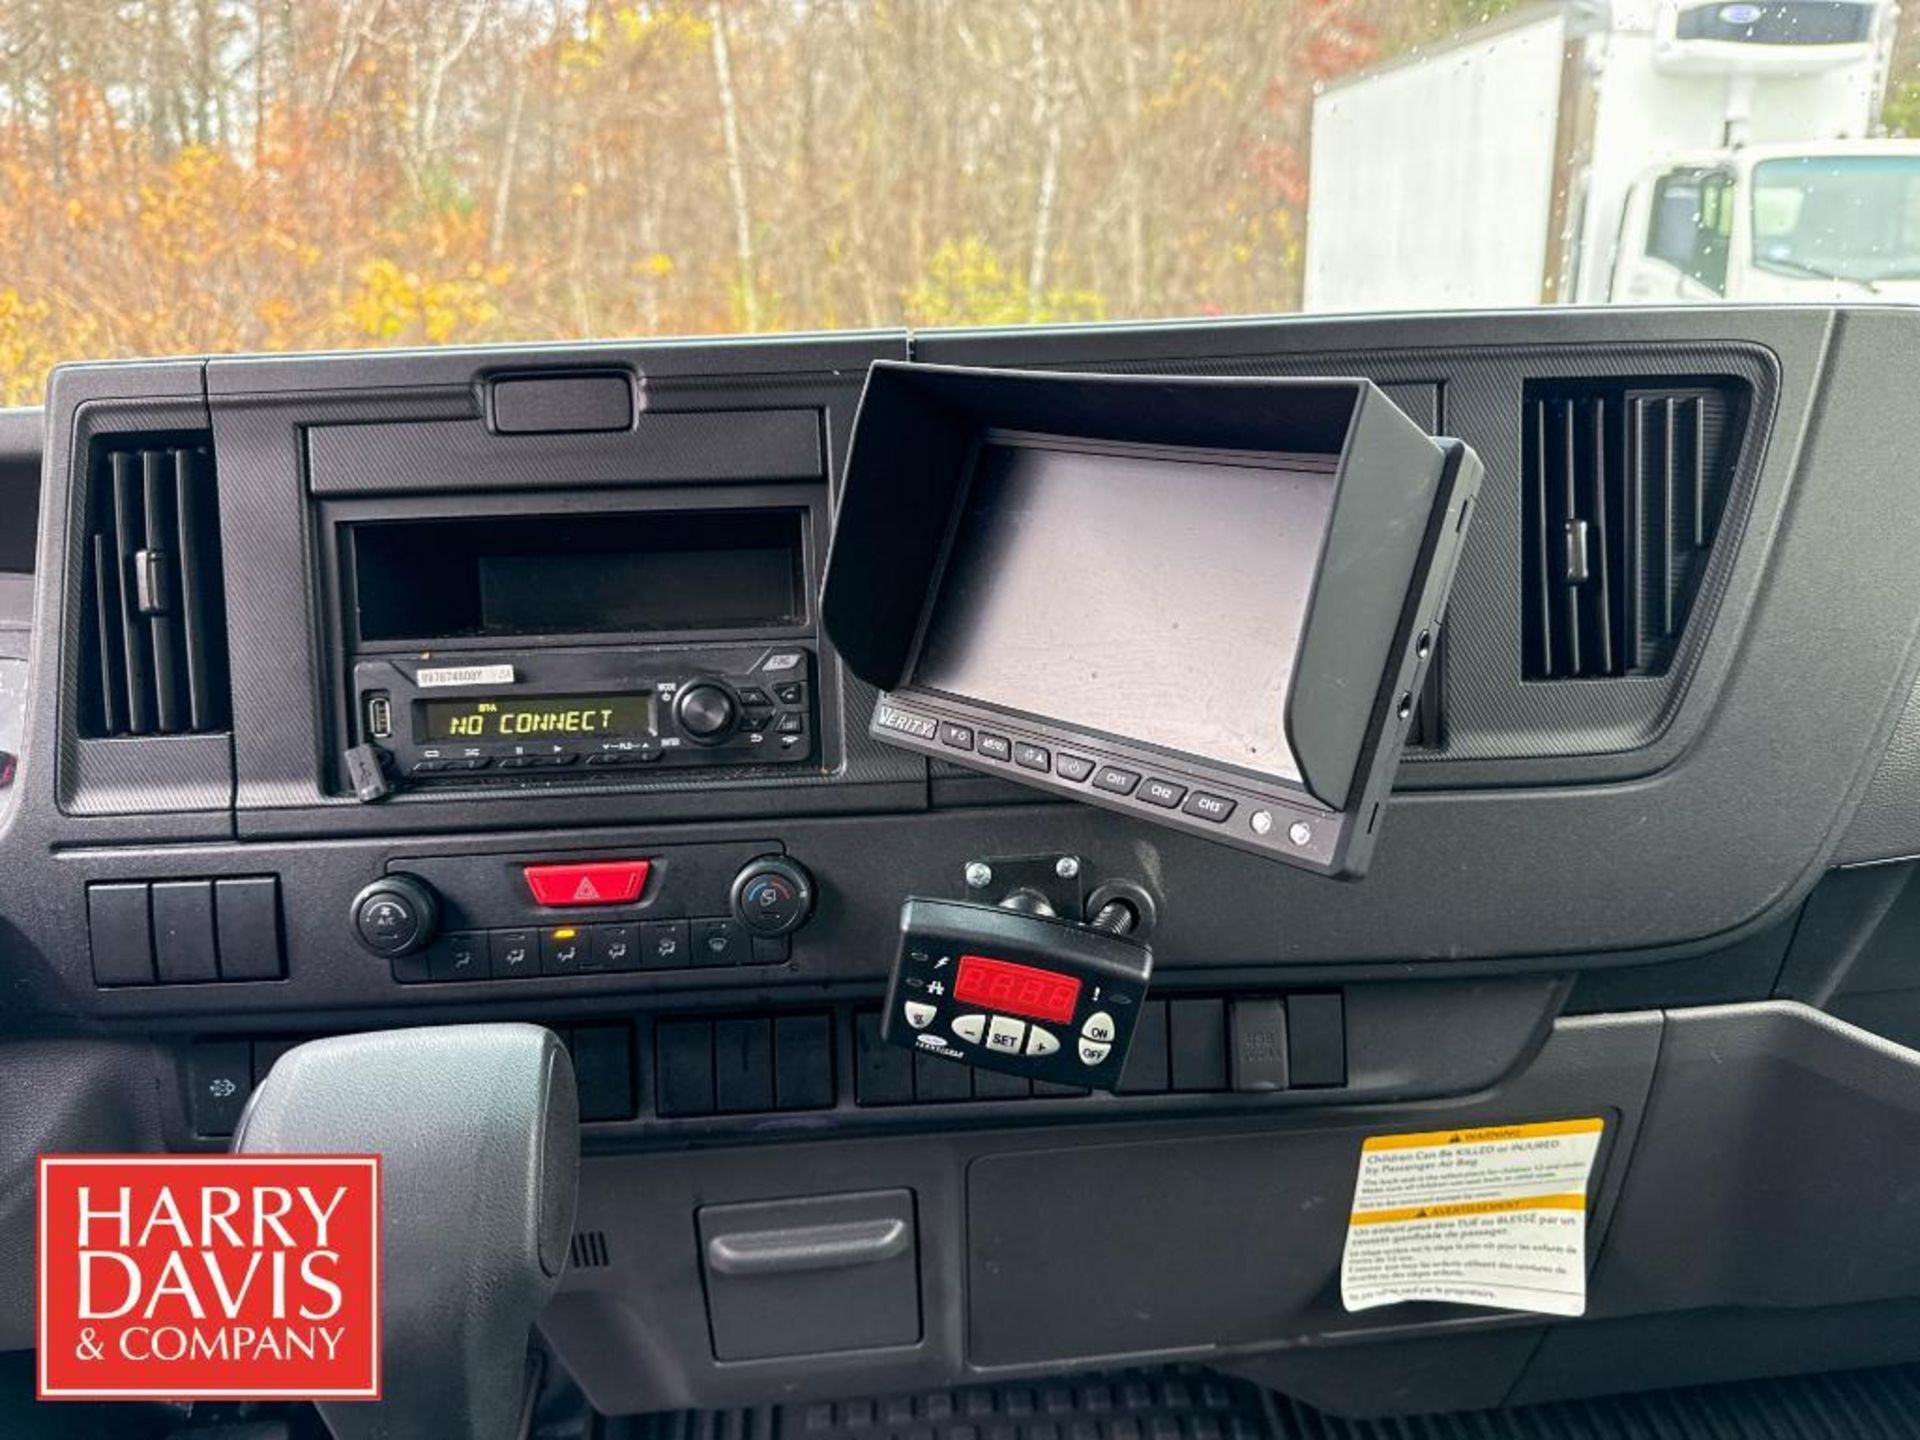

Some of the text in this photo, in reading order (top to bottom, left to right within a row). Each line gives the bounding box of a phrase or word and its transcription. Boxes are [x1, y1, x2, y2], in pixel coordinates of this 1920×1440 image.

[450, 708, 613, 735] NO CONNECT
[878, 705, 933, 736] VERITY
[1106, 772, 1127, 786] CH1
[1151, 784, 1172, 799] CH2
[1197, 797, 1221, 813] CH3
[992, 1033, 1018, 1048] SET
[1091, 1027, 1109, 1040] ON
[1082, 1047, 1105, 1060] OFF
[1465, 1129, 1521, 1141] WARNING
[1366, 1153, 1414, 1165] Children
[1416, 1151, 1437, 1160] Can
[1456, 1144, 1495, 1157] KILLED
[1511, 1140, 1560, 1151] INJURED
[1382, 1162, 1436, 1174] Passenger
